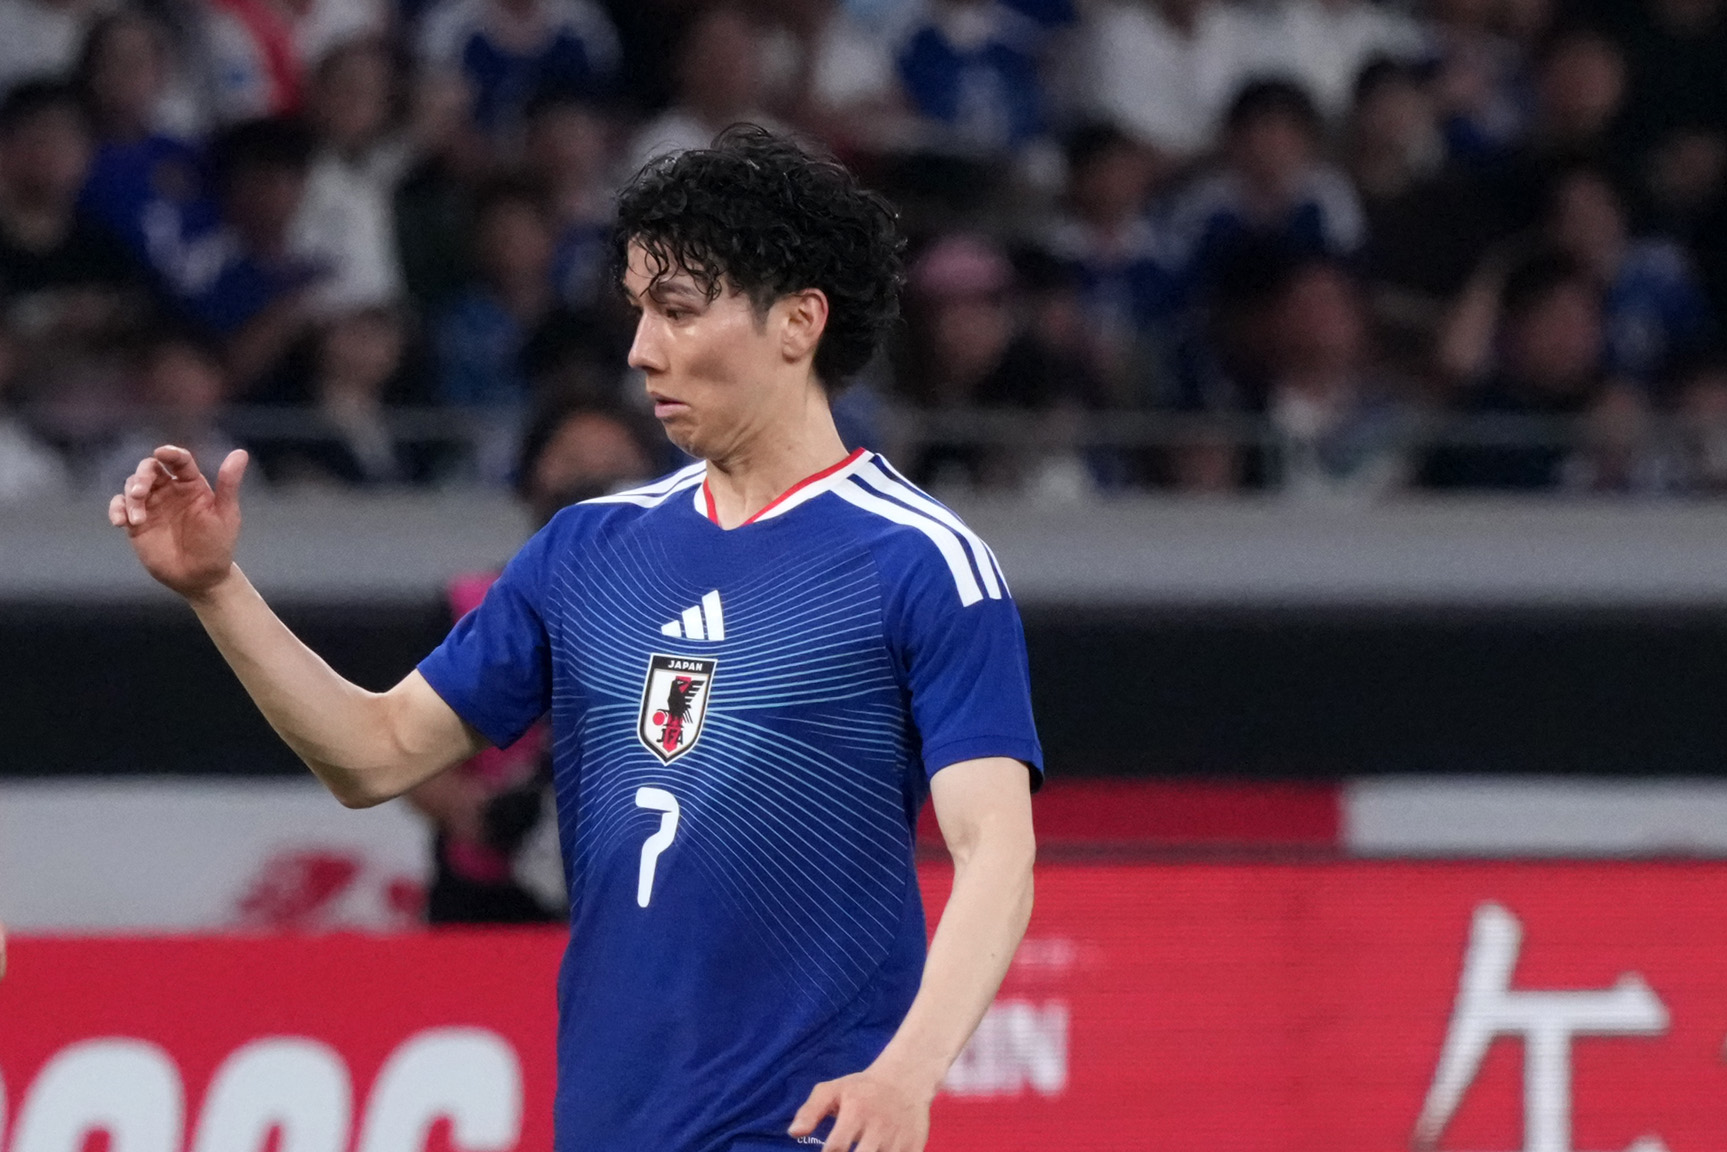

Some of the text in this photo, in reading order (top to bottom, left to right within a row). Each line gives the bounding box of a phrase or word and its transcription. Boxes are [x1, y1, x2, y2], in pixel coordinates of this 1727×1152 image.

[667, 659, 703, 672] JAPAN
[656, 727, 684, 746] JFA
[634, 787, 680, 909] 7
